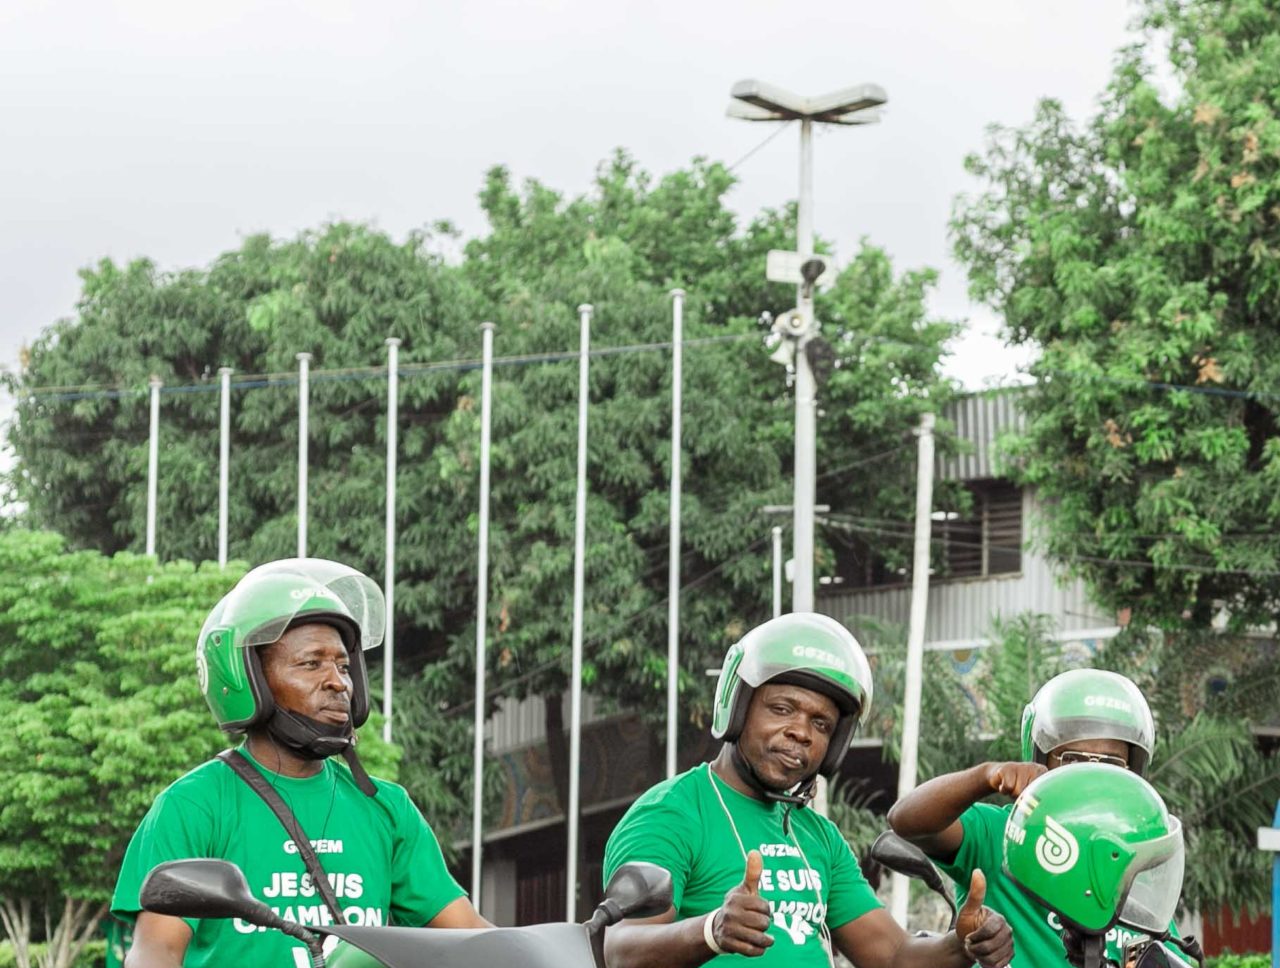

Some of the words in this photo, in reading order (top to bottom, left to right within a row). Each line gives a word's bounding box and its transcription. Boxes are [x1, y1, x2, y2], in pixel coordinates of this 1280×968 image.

[283, 840, 343, 853] GZEM
[263, 872, 298, 898] JE
[299, 872, 363, 898] SIS
[758, 868, 775, 891] E
[776, 868, 822, 891] SUIS
